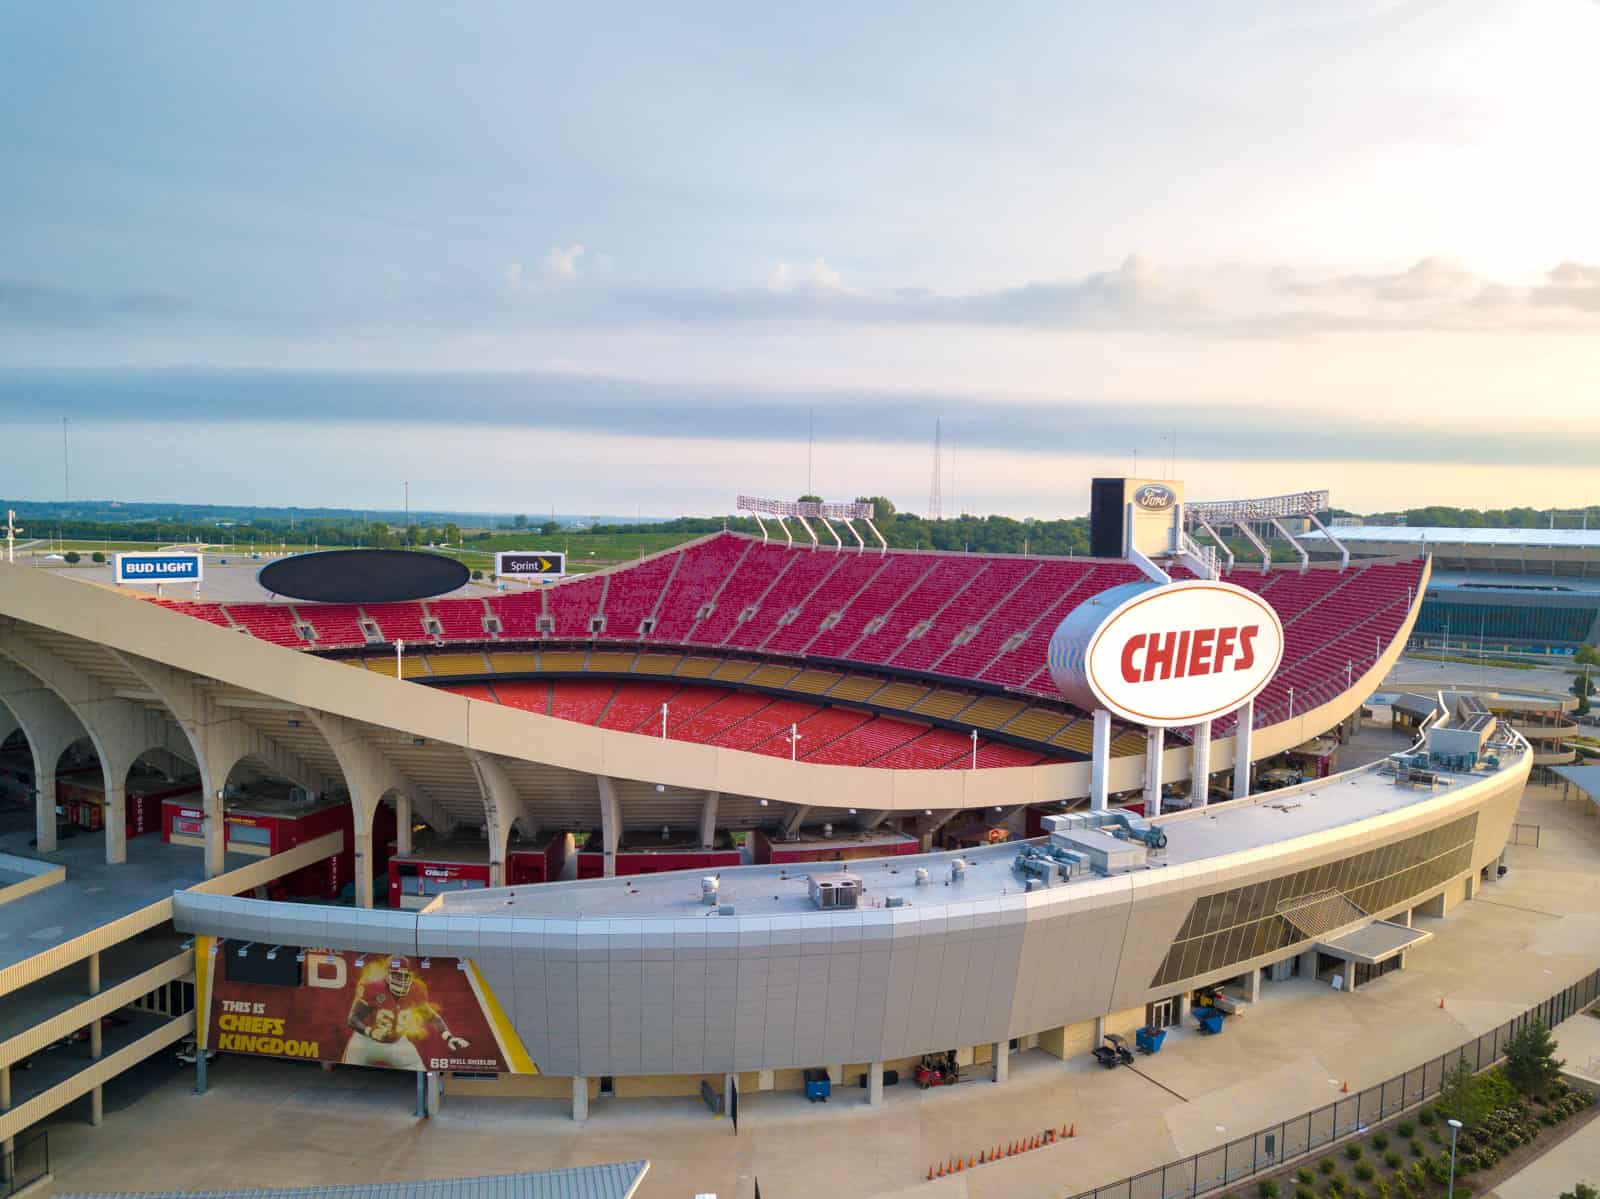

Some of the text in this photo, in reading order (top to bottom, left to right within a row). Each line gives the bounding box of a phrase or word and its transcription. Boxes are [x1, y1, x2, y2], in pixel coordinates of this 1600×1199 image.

[1142, 487, 1169, 506] Ford
[126, 562, 193, 573] BUD LIGHT
[511, 561, 539, 573] Sprint
[1121, 625, 1259, 684] CHIEFS
[307, 954, 347, 989] D
[222, 1000, 266, 1015] THIS IS
[219, 1013, 286, 1036] CHIEFS
[218, 1033, 320, 1059] KINGDOM
[430, 1058, 449, 1069] 68
